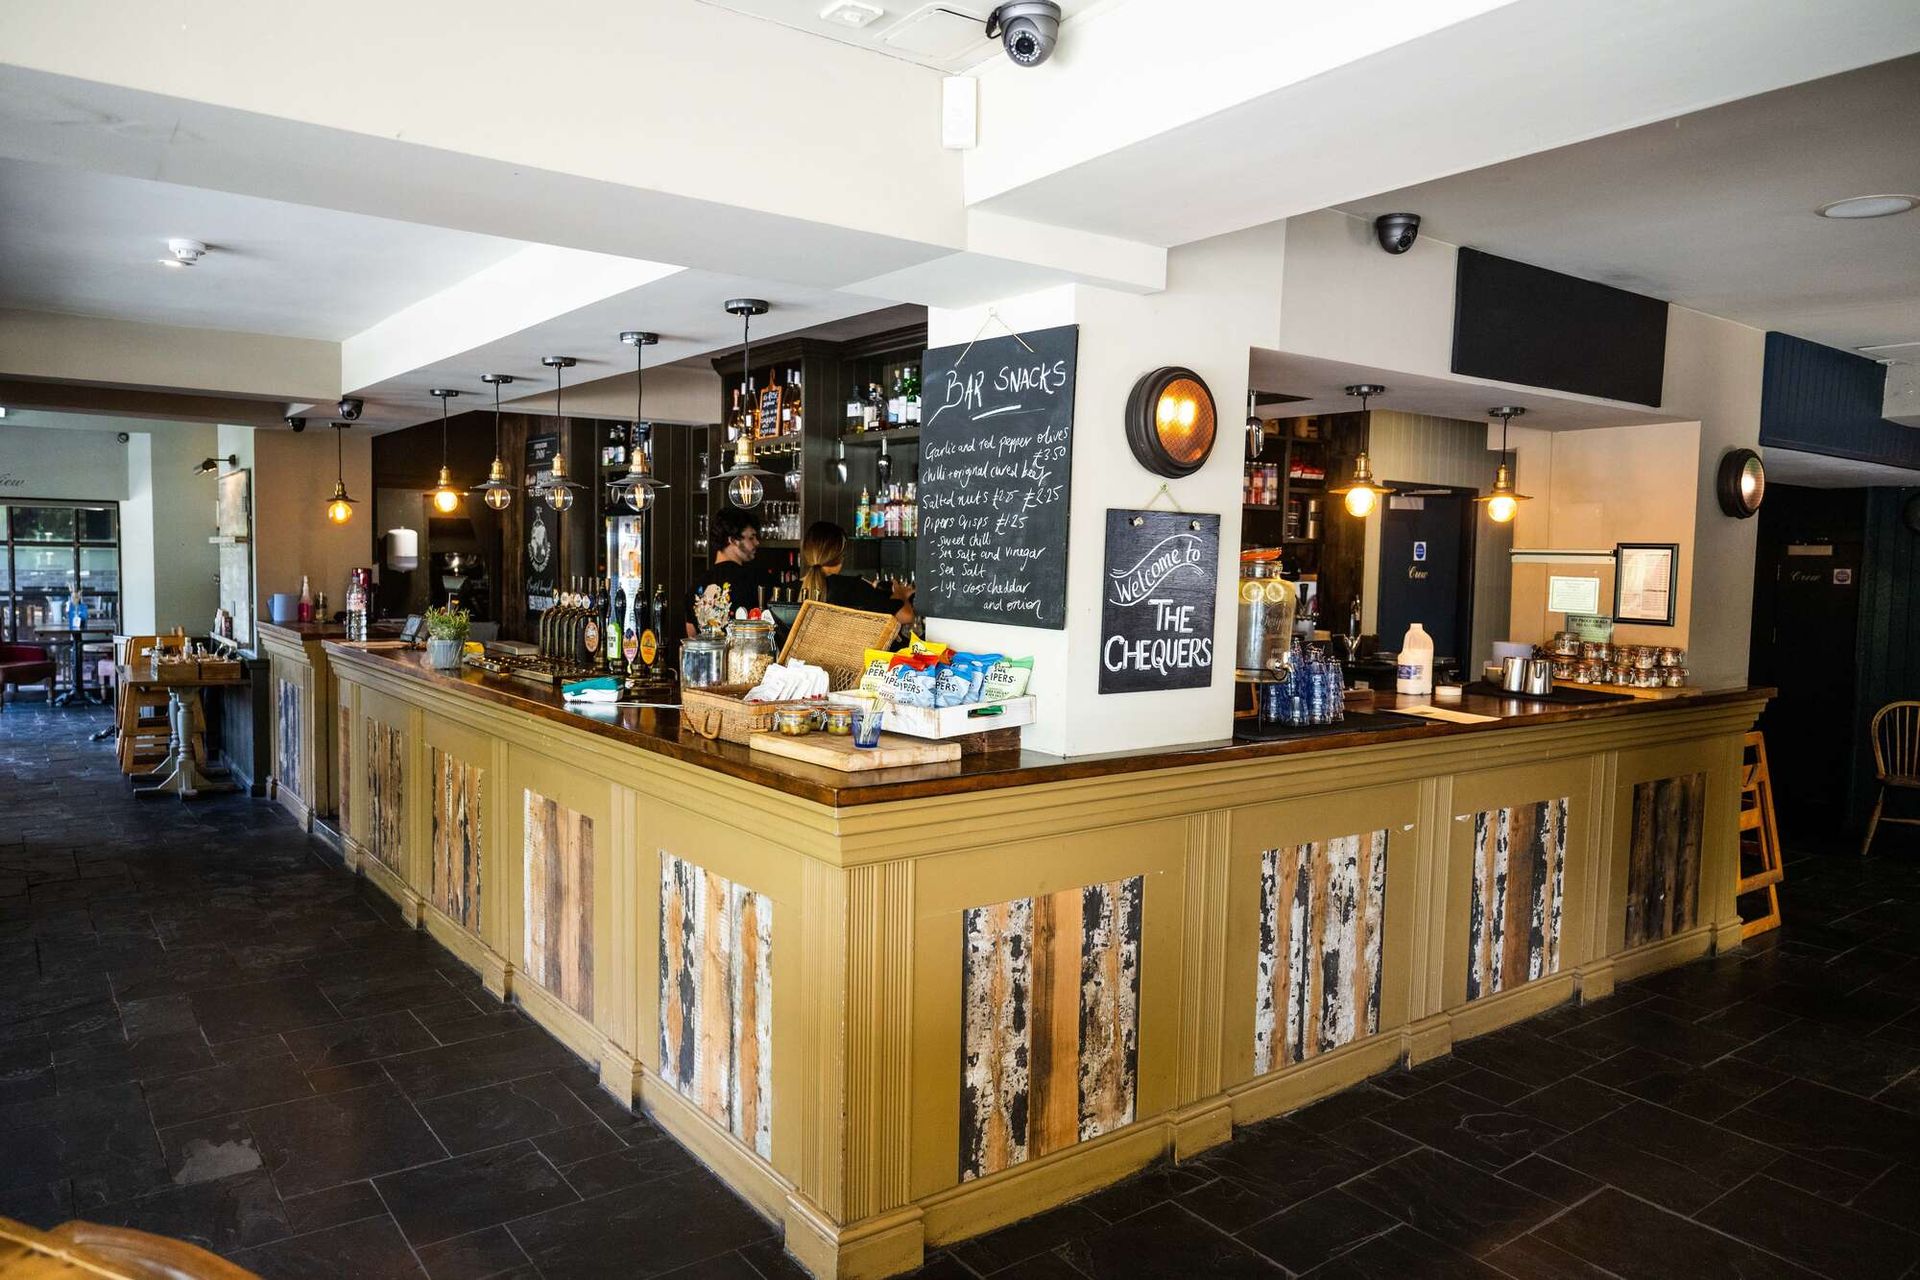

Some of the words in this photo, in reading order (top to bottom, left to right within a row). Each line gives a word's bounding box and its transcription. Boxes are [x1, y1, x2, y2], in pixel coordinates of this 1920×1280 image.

[934, 370, 985, 419] BAR
[994, 361, 1066, 394] SNACKS
[925, 440, 955, 462] Garlic
[956, 438, 975, 452] and
[979, 434, 996, 449] red
[998, 436, 1032, 457] pepper
[1036, 425, 1069, 445] olives
[953, 460, 989, 488] original
[990, 462, 1018, 478] cured
[922, 490, 955, 509] Salted
[957, 489, 989, 506] nuts
[980, 546, 1001, 560] and
[1114, 549, 1182, 603] Welcome
[1186, 540, 1201, 563] to
[983, 598, 1003, 612] and
[1006, 598, 1044, 620] onion
[1148, 599, 1195, 634] THE
[1104, 634, 1212, 676] CHEQUERS
